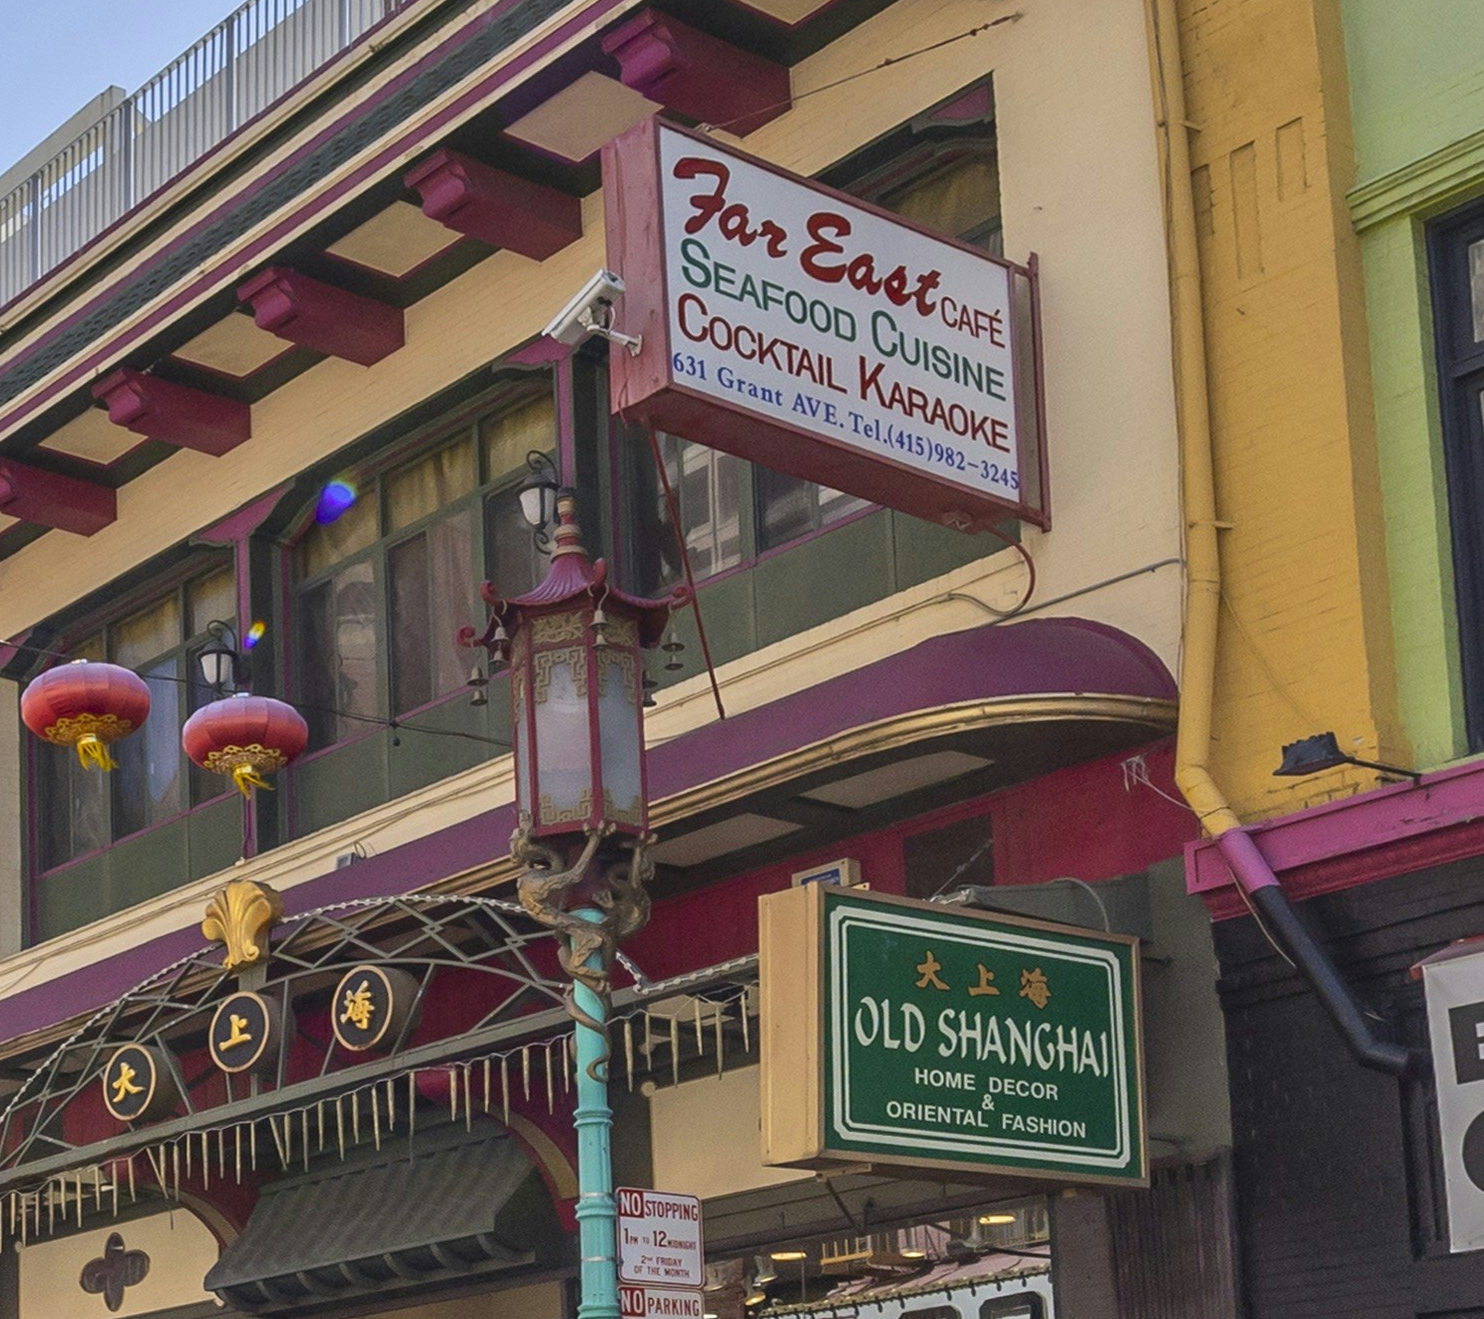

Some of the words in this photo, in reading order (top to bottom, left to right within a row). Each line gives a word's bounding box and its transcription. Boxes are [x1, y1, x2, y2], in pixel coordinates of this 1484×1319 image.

[673, 157, 787, 260] Far
[799, 211, 941, 317] East
[941, 294, 1006, 349] CAFÉ
[681, 237, 857, 342] SEAFOOD
[870, 310, 1007, 401] CUISINE
[672, 352, 709, 379] 631
[717, 366, 784, 408] Grant
[791, 394, 845, 430] AVE.
[677, 292, 847, 394] COCKTAIL
[858, 355, 1010, 454] KARAOKE
[914, 950, 1053, 1009] 大上海
[854, 996, 927, 1054] OLD
[937, 1007, 1109, 1078] SHANGHAI
[914, 1067, 976, 1091] HOME
[988, 1076, 1059, 1101] DECOR
[981, 1093, 996, 1111] &
[885, 1100, 989, 1128] ORIENTAL
[1001, 1113, 1087, 1139] FASHION
[620, 1190, 642, 1216] NO
[644, 1199, 699, 1221] STOPPING
[633, 1265, 645, 1275] OF
[646, 1266, 661, 1277] THE
[664, 1267, 690, 1279] MONTH
[656, 1255, 683, 1268] FRIDAY
[620, 1289, 643, 1315] NO
[647, 1296, 700, 1317] PARKING
